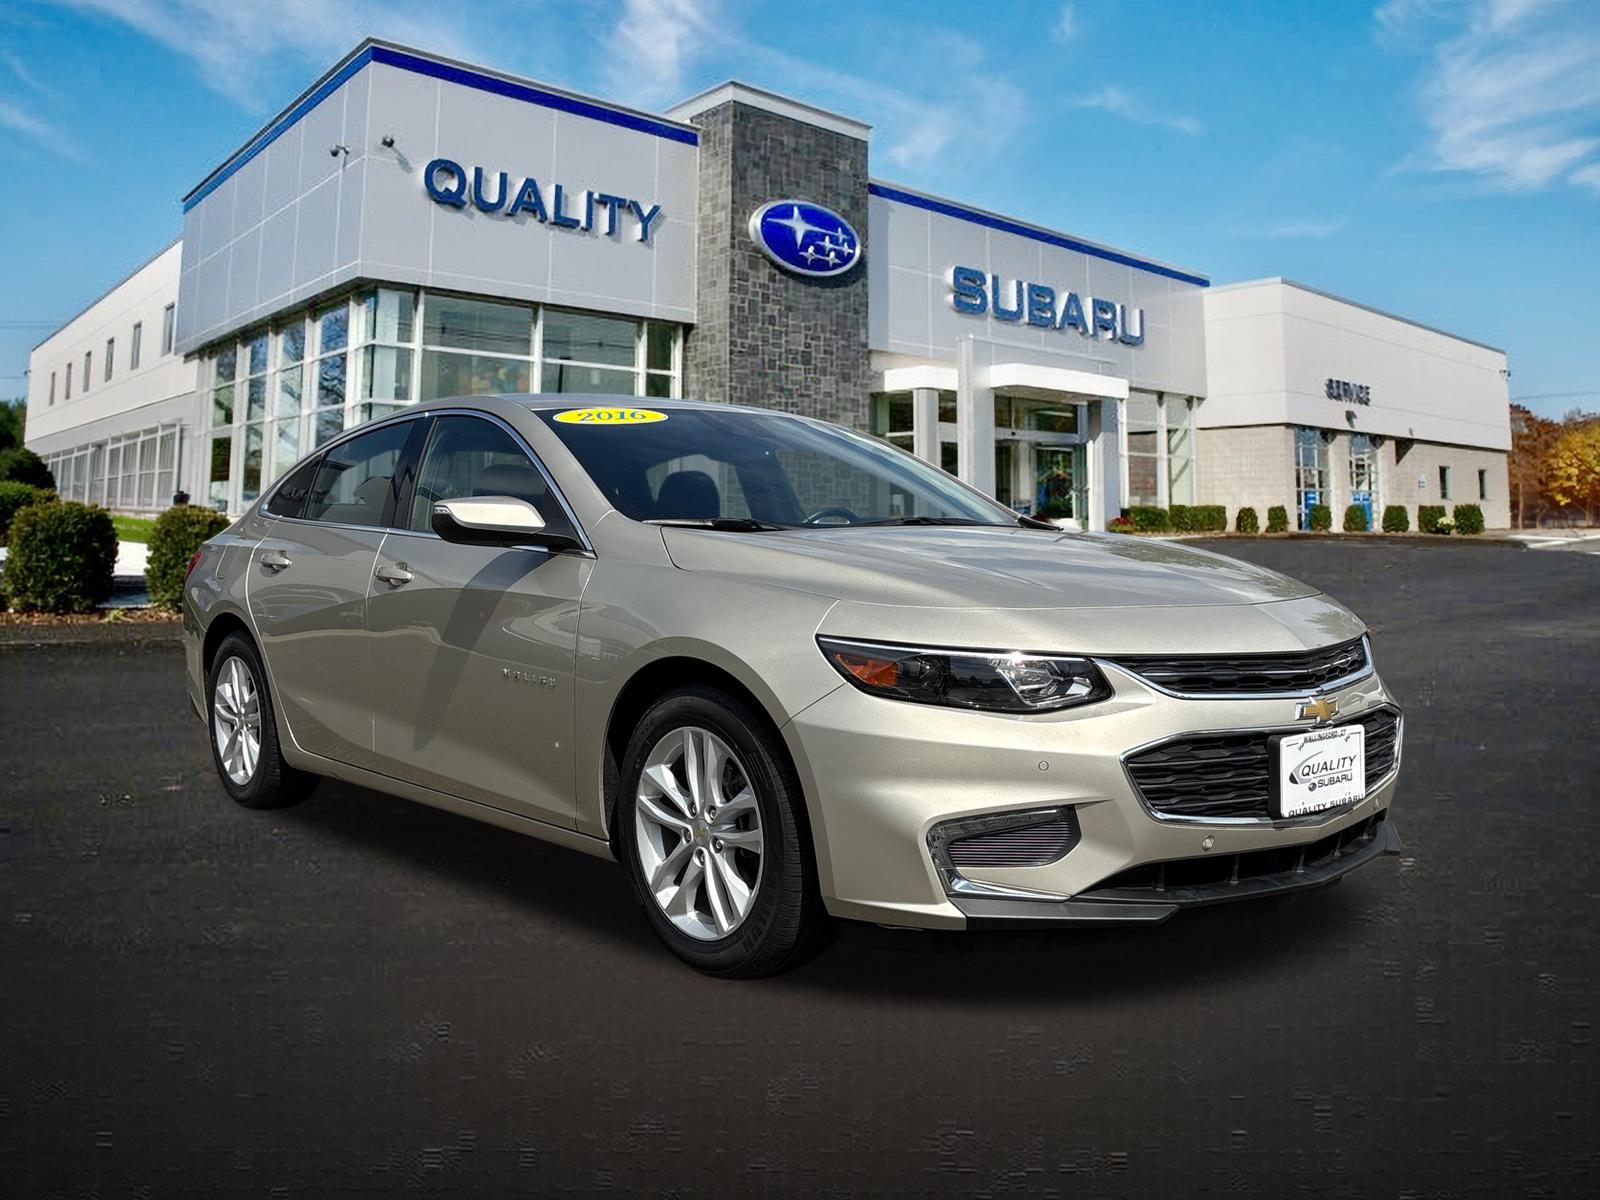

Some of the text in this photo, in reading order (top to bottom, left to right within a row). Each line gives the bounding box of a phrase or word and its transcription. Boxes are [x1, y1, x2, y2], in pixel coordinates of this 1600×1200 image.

[424, 158, 662, 243] QUALITY
[950, 265, 1144, 346] SUBARU
[577, 411, 646, 421] 2016
[1301, 755, 1356, 777] QUALITY
[1317, 772, 1353, 788] SUBARU
[1288, 794, 1364, 817] QUALITY SUBARU
